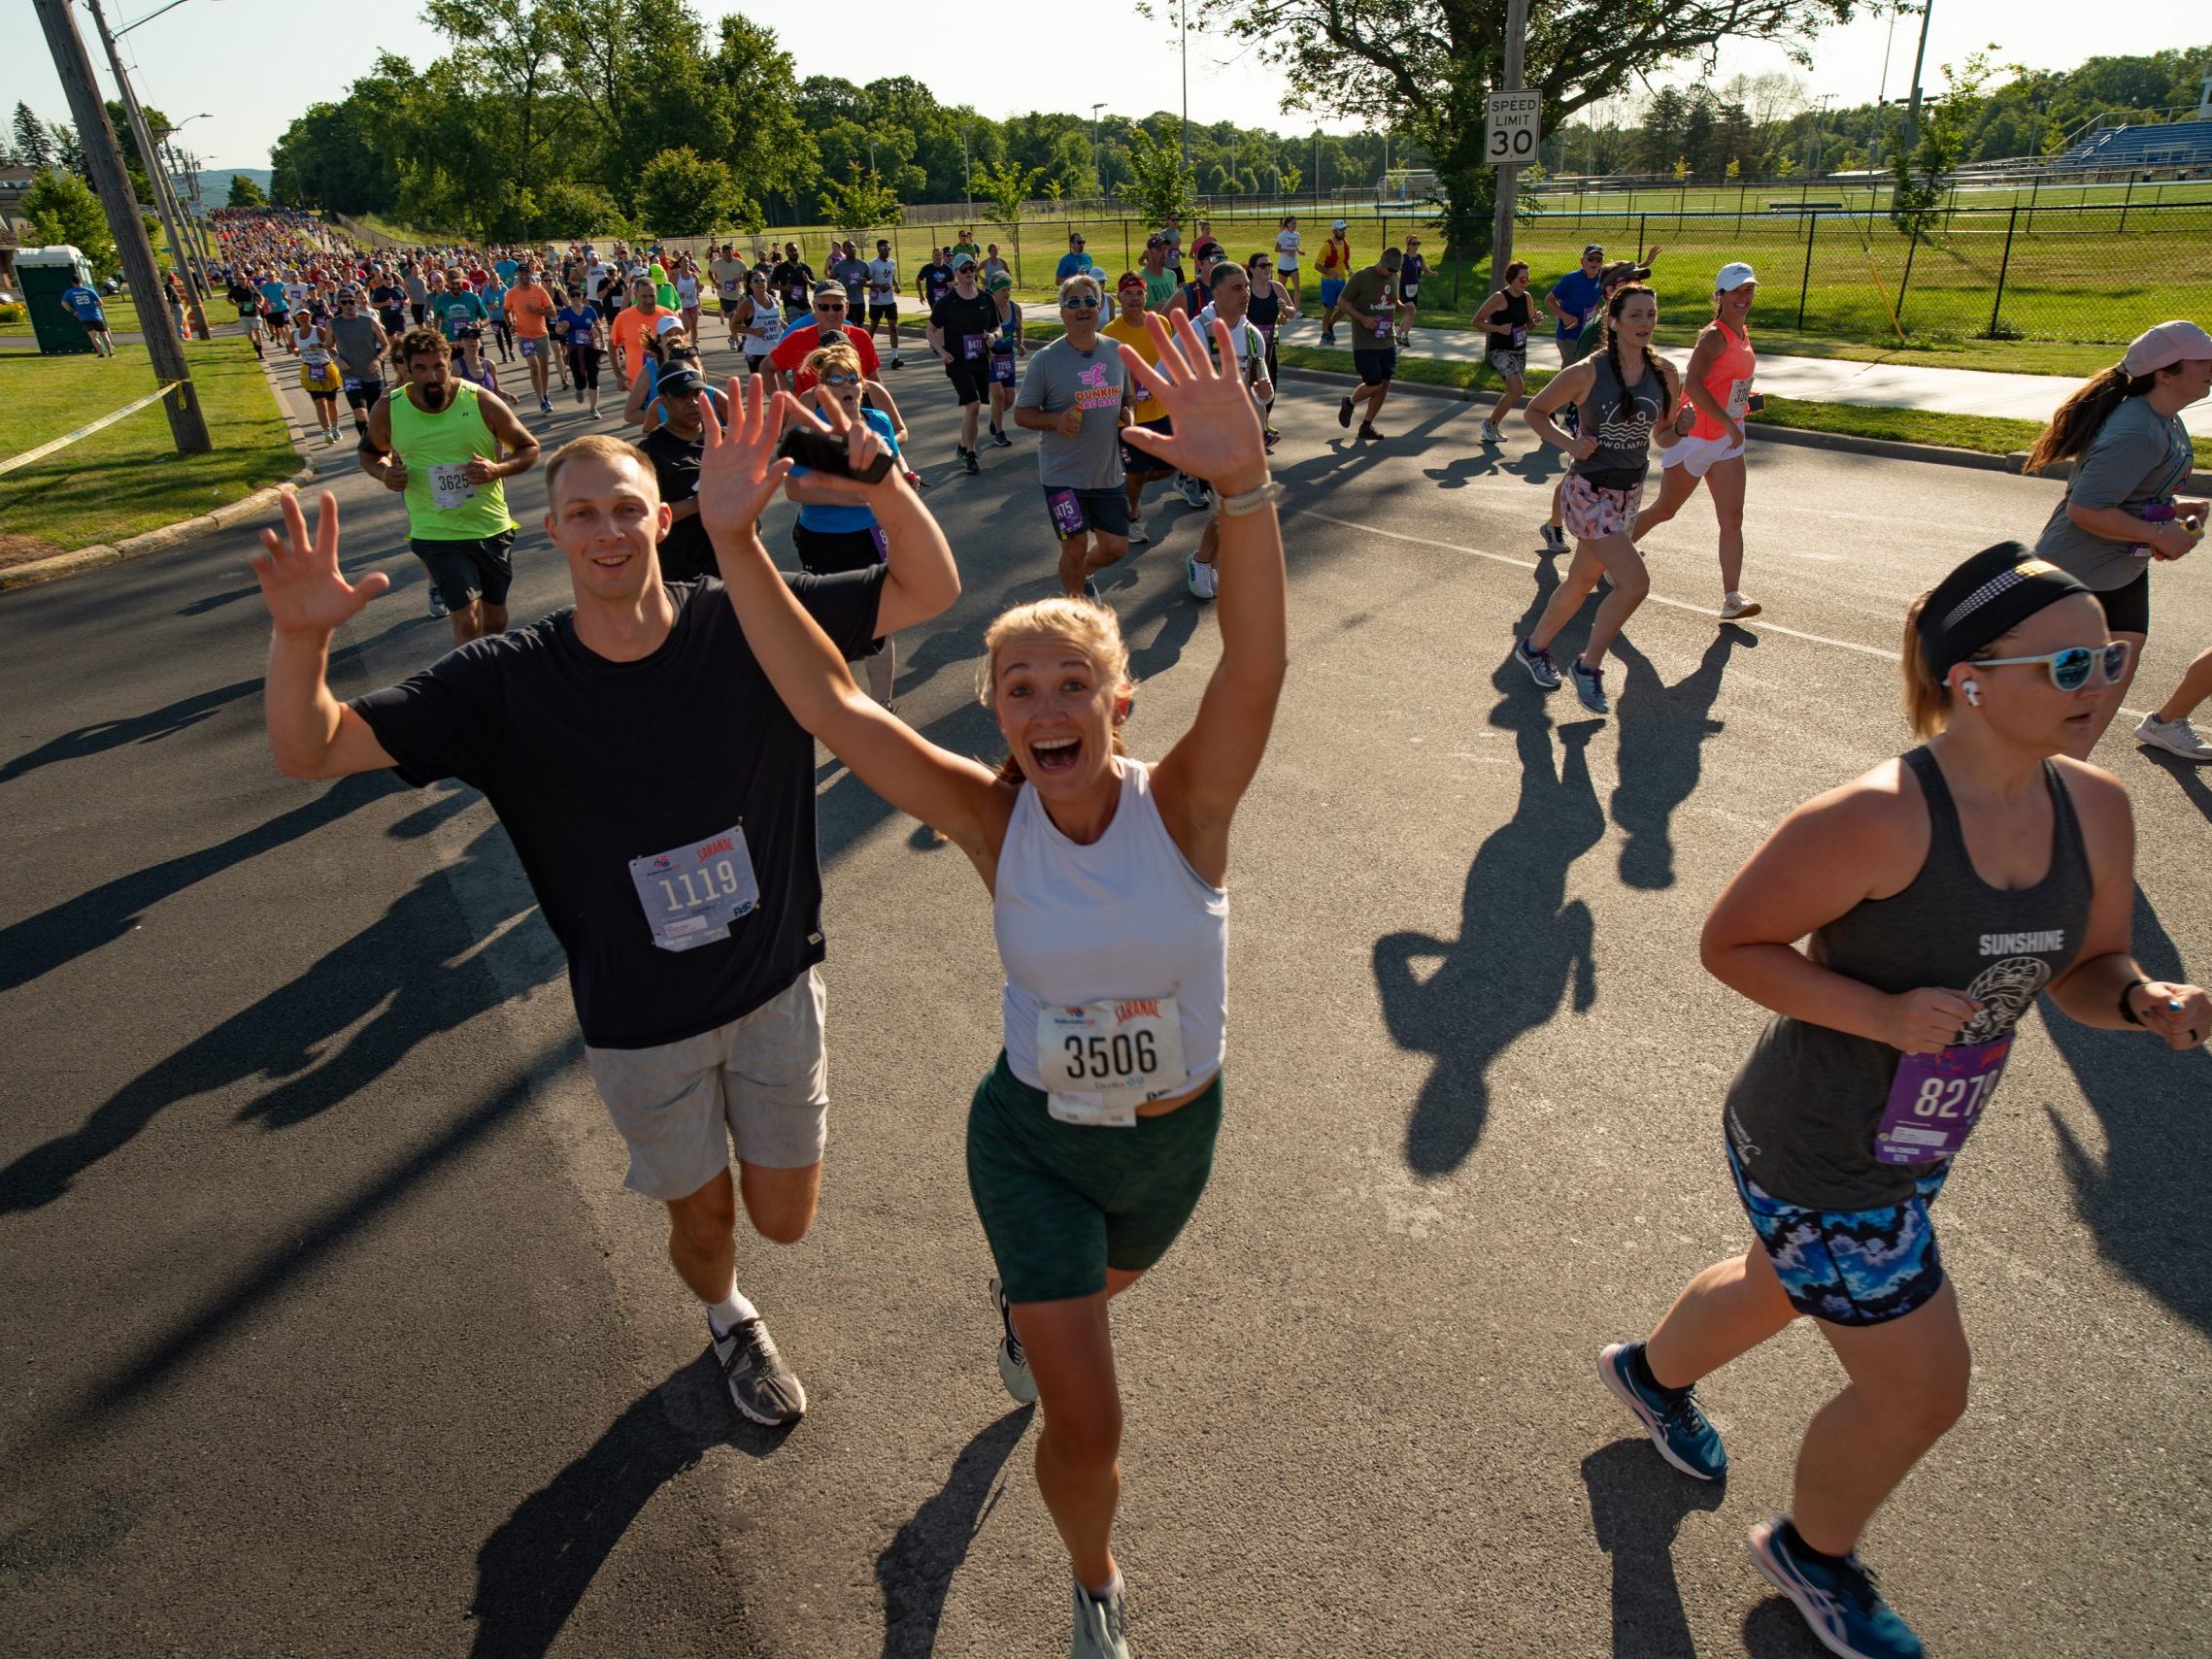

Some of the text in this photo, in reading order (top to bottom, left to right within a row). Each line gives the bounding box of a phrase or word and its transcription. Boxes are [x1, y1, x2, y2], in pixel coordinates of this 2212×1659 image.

[1491, 100, 1536, 112] SPEED
[1495, 115, 1530, 126] LIMIT
[1491, 129, 1533, 155] 30
[75, 295, 90, 305] 29
[1075, 386, 1120, 403] DUNKIN
[438, 473, 470, 491] 3625
[658, 860, 738, 912] 1119
[1978, 929, 2065, 956] SUNSHINE
[1064, 1029, 1157, 1079] 3506
